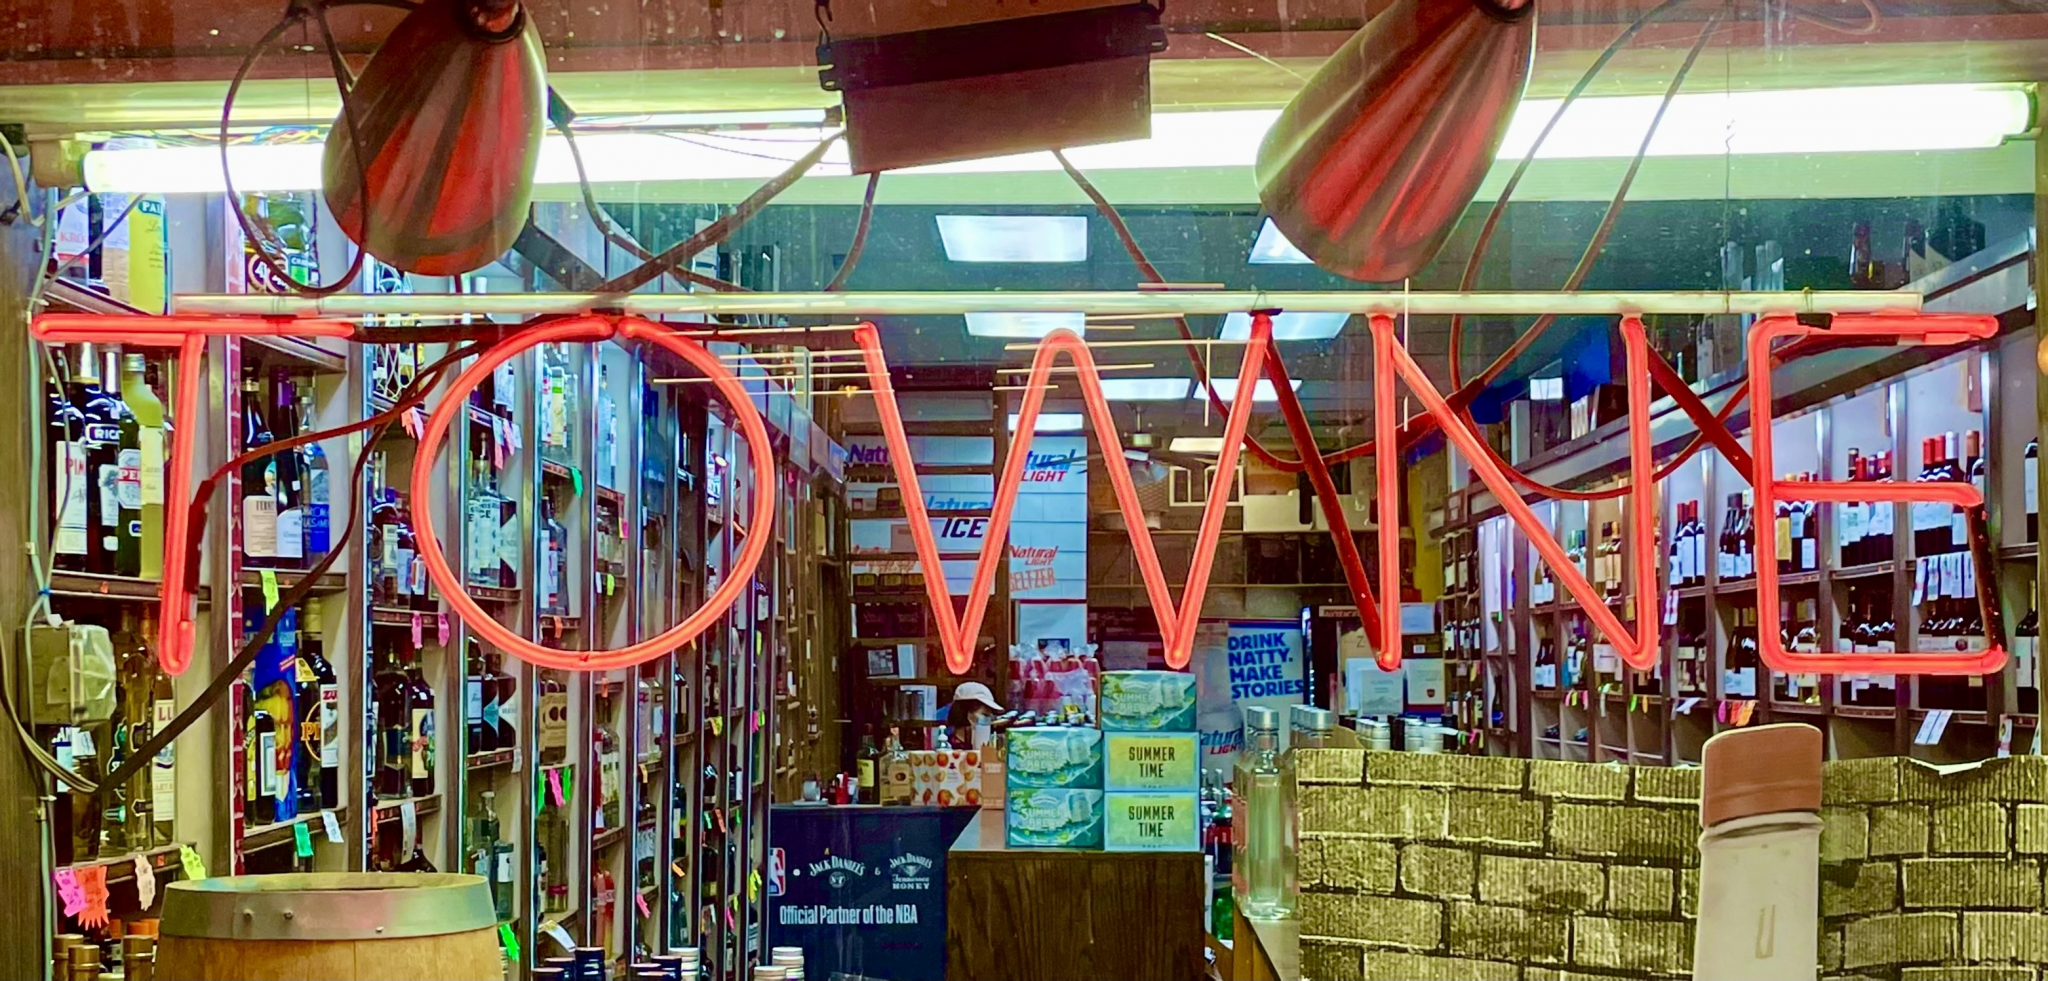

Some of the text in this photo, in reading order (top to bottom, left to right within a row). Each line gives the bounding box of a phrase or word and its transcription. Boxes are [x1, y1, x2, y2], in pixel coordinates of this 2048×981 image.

[1024, 448, 1076, 472] tural
[1021, 470, 1067, 482] LIGHT
[29, 310, 2008, 676] TOWNE
[941, 518, 989, 538] ICE
[1009, 545, 1059, 558] Natural
[1227, 632, 1286, 651] DRINK
[1227, 647, 1293, 667] NATTY.
[1229, 665, 1283, 683] MAKE
[1231, 679, 1304, 699] STORIES
[1128, 746, 1175, 762] SUMMER
[1139, 763, 1164, 778] TIME
[1128, 805, 1175, 821] SUMMER
[1138, 822, 1164, 837] TIME
[808, 859, 832, 877] JACK
[892, 882, 930, 890] HONEY
[779, 904, 918, 925] Official Partner of the NBA
